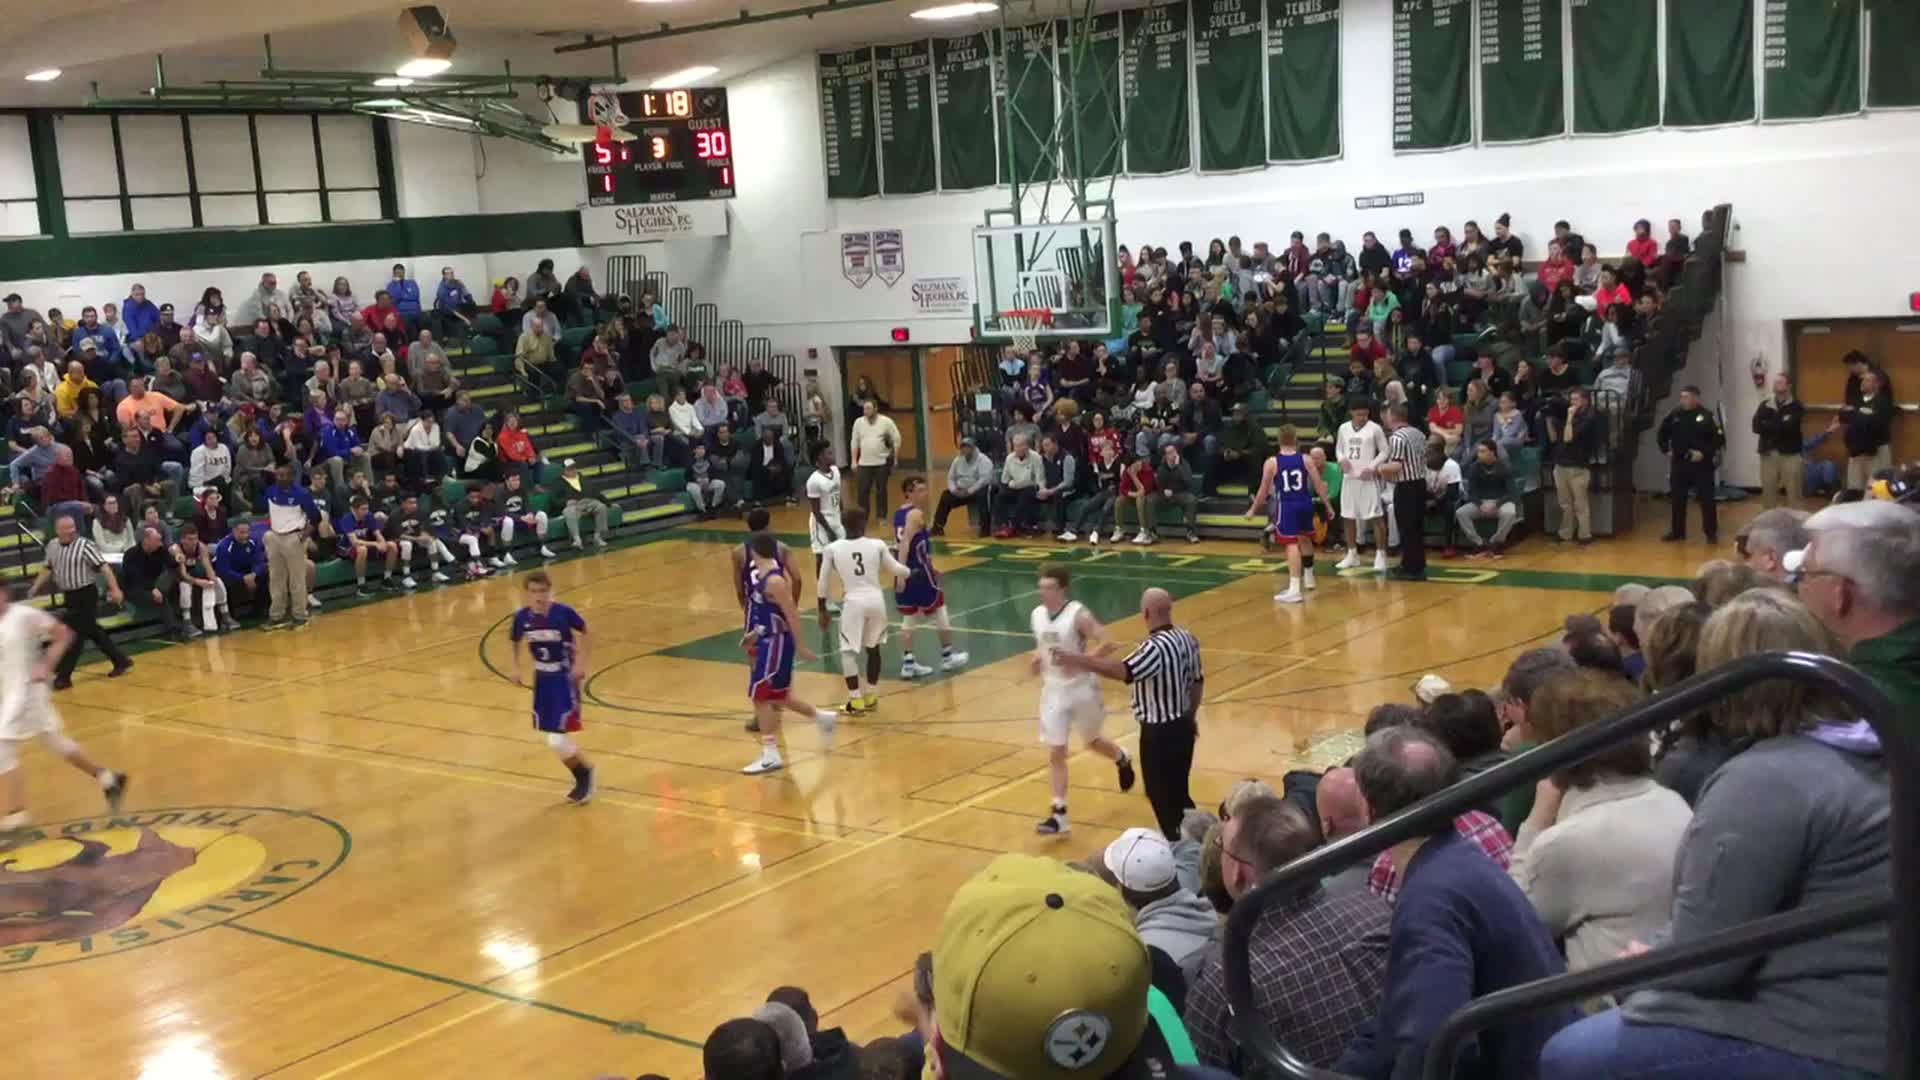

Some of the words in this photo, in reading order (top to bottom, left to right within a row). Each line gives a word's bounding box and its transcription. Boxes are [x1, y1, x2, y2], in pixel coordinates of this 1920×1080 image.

[643, 90, 689, 116] 1:18
[687, 118, 721, 131] GUEST
[652, 137, 665, 159] 3
[696, 131, 727, 158] 30
[615, 205, 678, 230] SALZMANN
[1281, 469, 1303, 492] 13
[852, 551, 866, 577] 3
